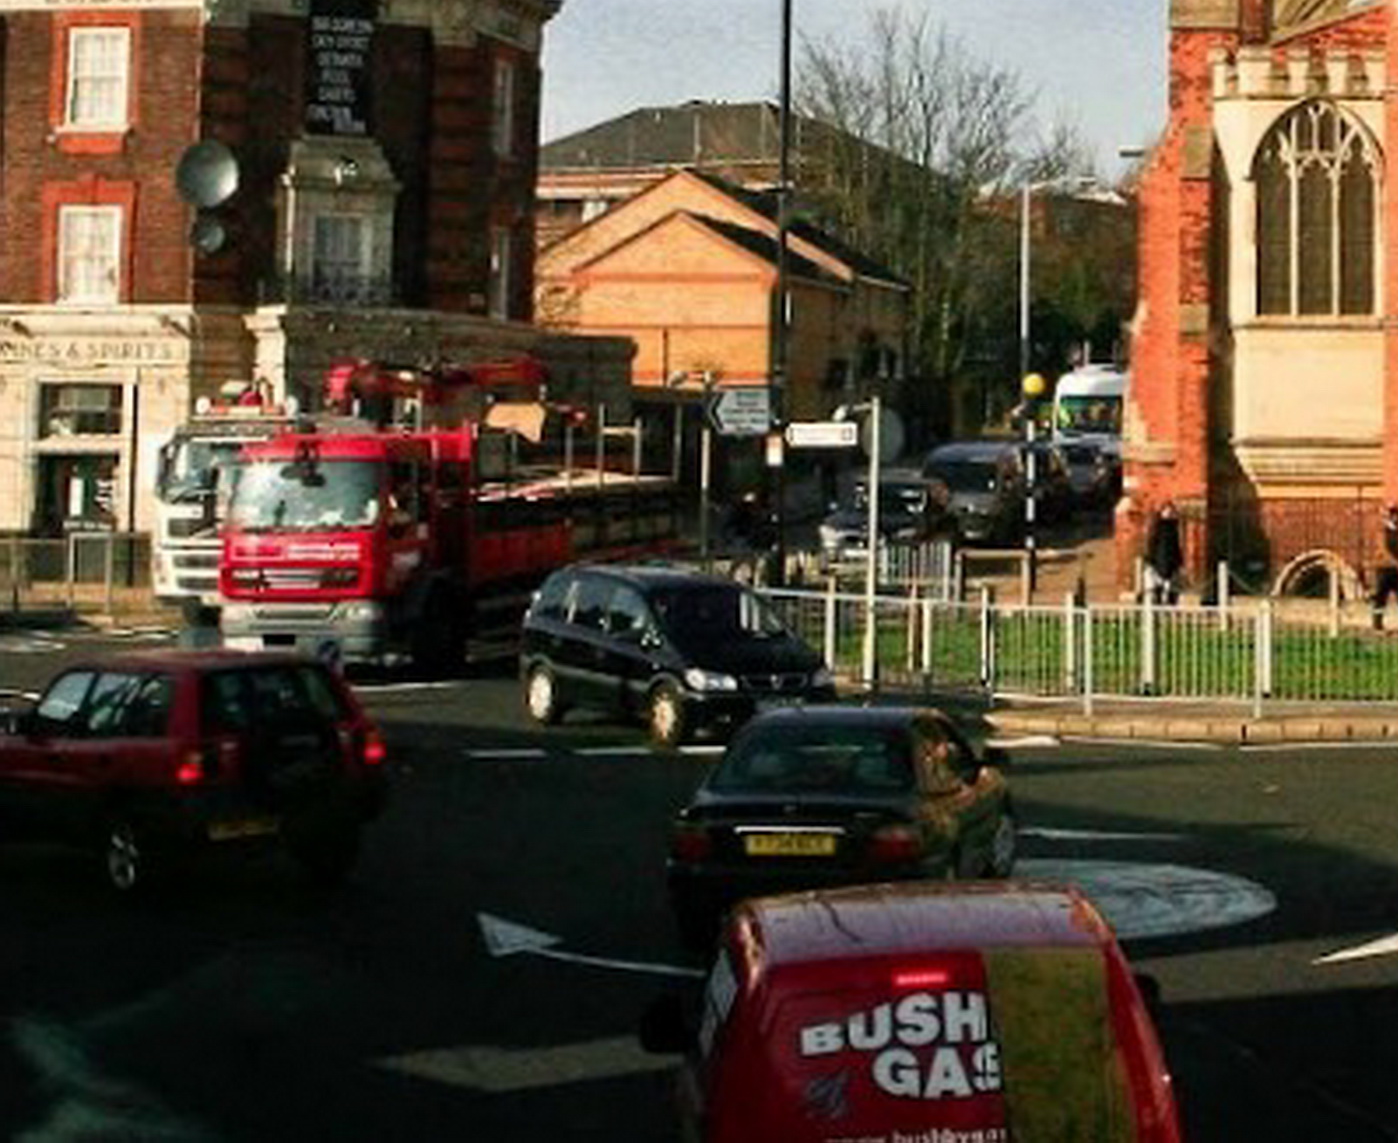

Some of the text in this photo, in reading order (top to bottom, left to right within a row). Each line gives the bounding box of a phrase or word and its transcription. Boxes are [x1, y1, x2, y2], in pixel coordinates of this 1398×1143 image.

[66, 342, 80, 357] &
[87, 342, 173, 359] SPIRITS
[801, 991, 988, 1057] BUSH
